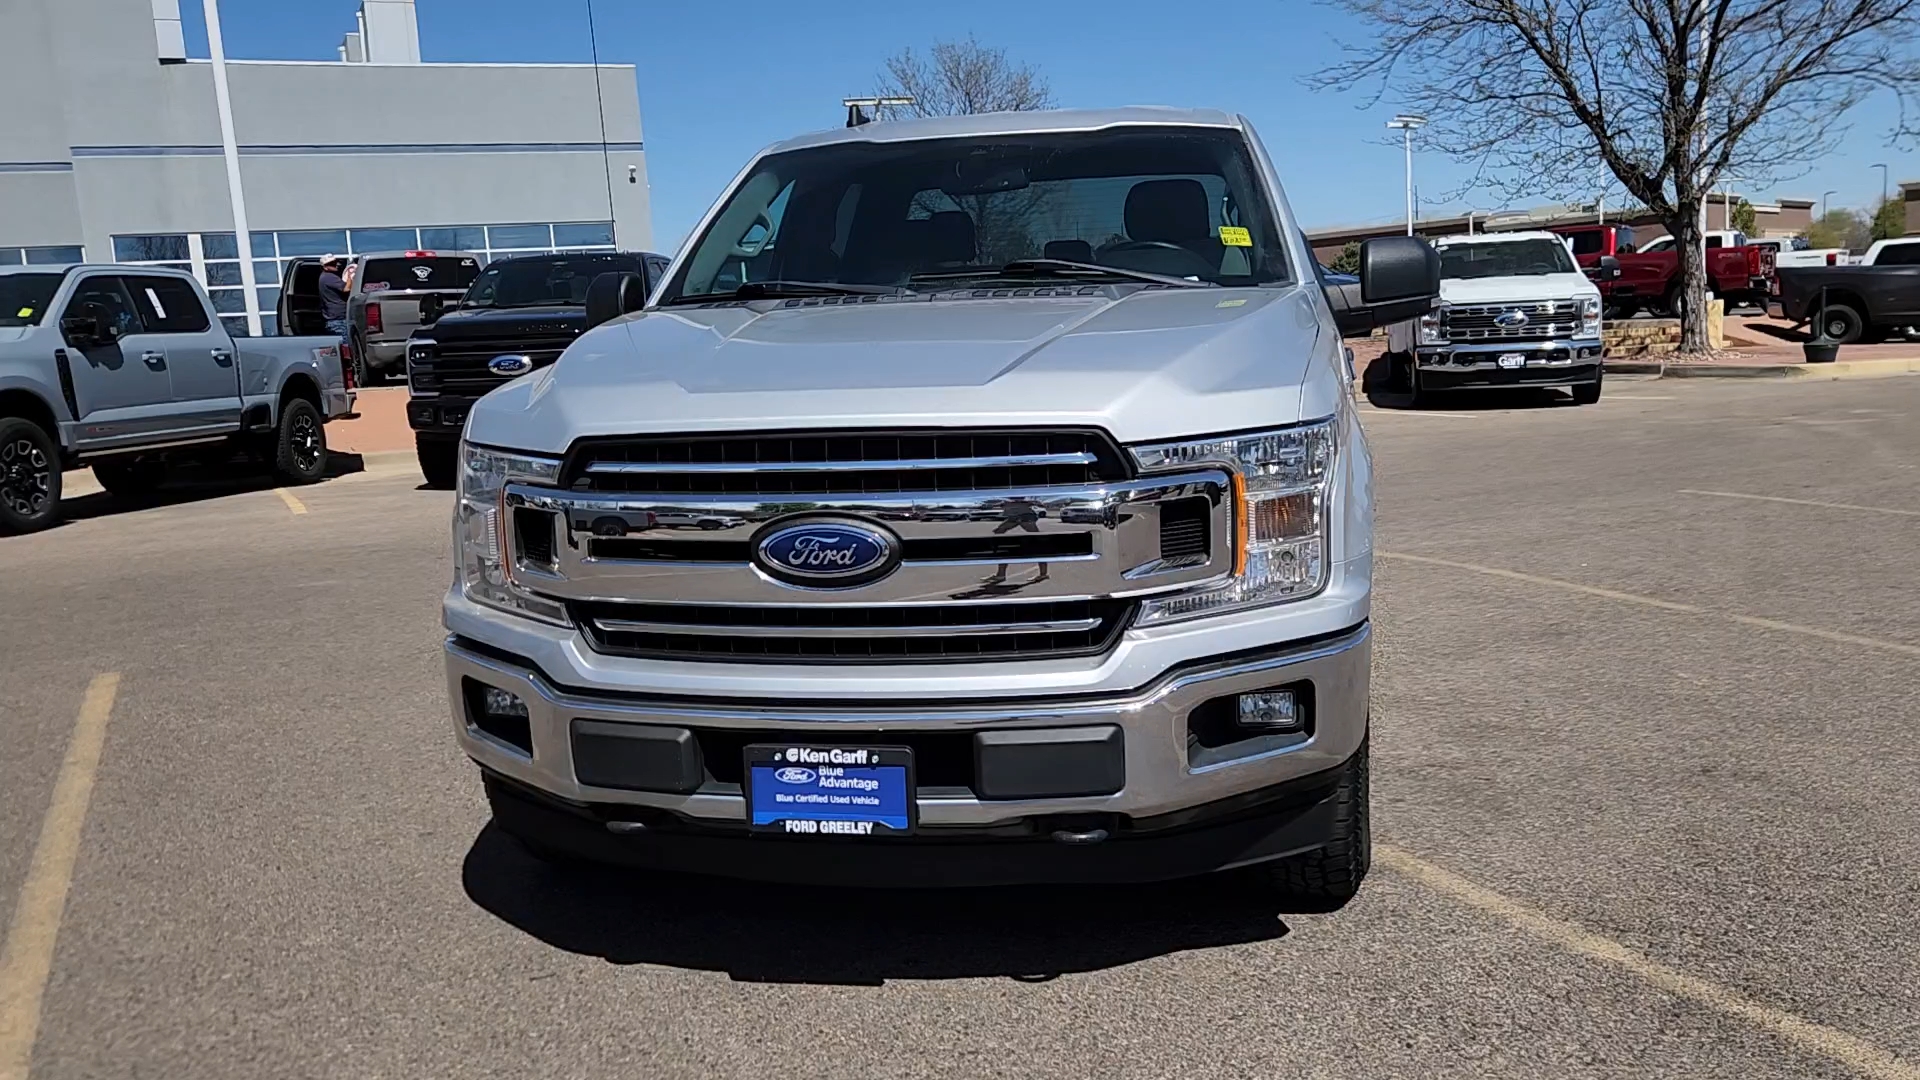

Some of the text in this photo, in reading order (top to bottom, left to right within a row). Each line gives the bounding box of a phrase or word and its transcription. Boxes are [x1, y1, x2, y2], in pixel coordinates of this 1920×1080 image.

[788, 535, 857, 565] Ford
[782, 768, 809, 780] Ford
[819, 766, 844, 776] Blue
[819, 777, 879, 791] Advantage
[776, 794, 879, 805] Blue Certified Used Vehicle
[786, 820, 874, 834] FORD GREELEY
